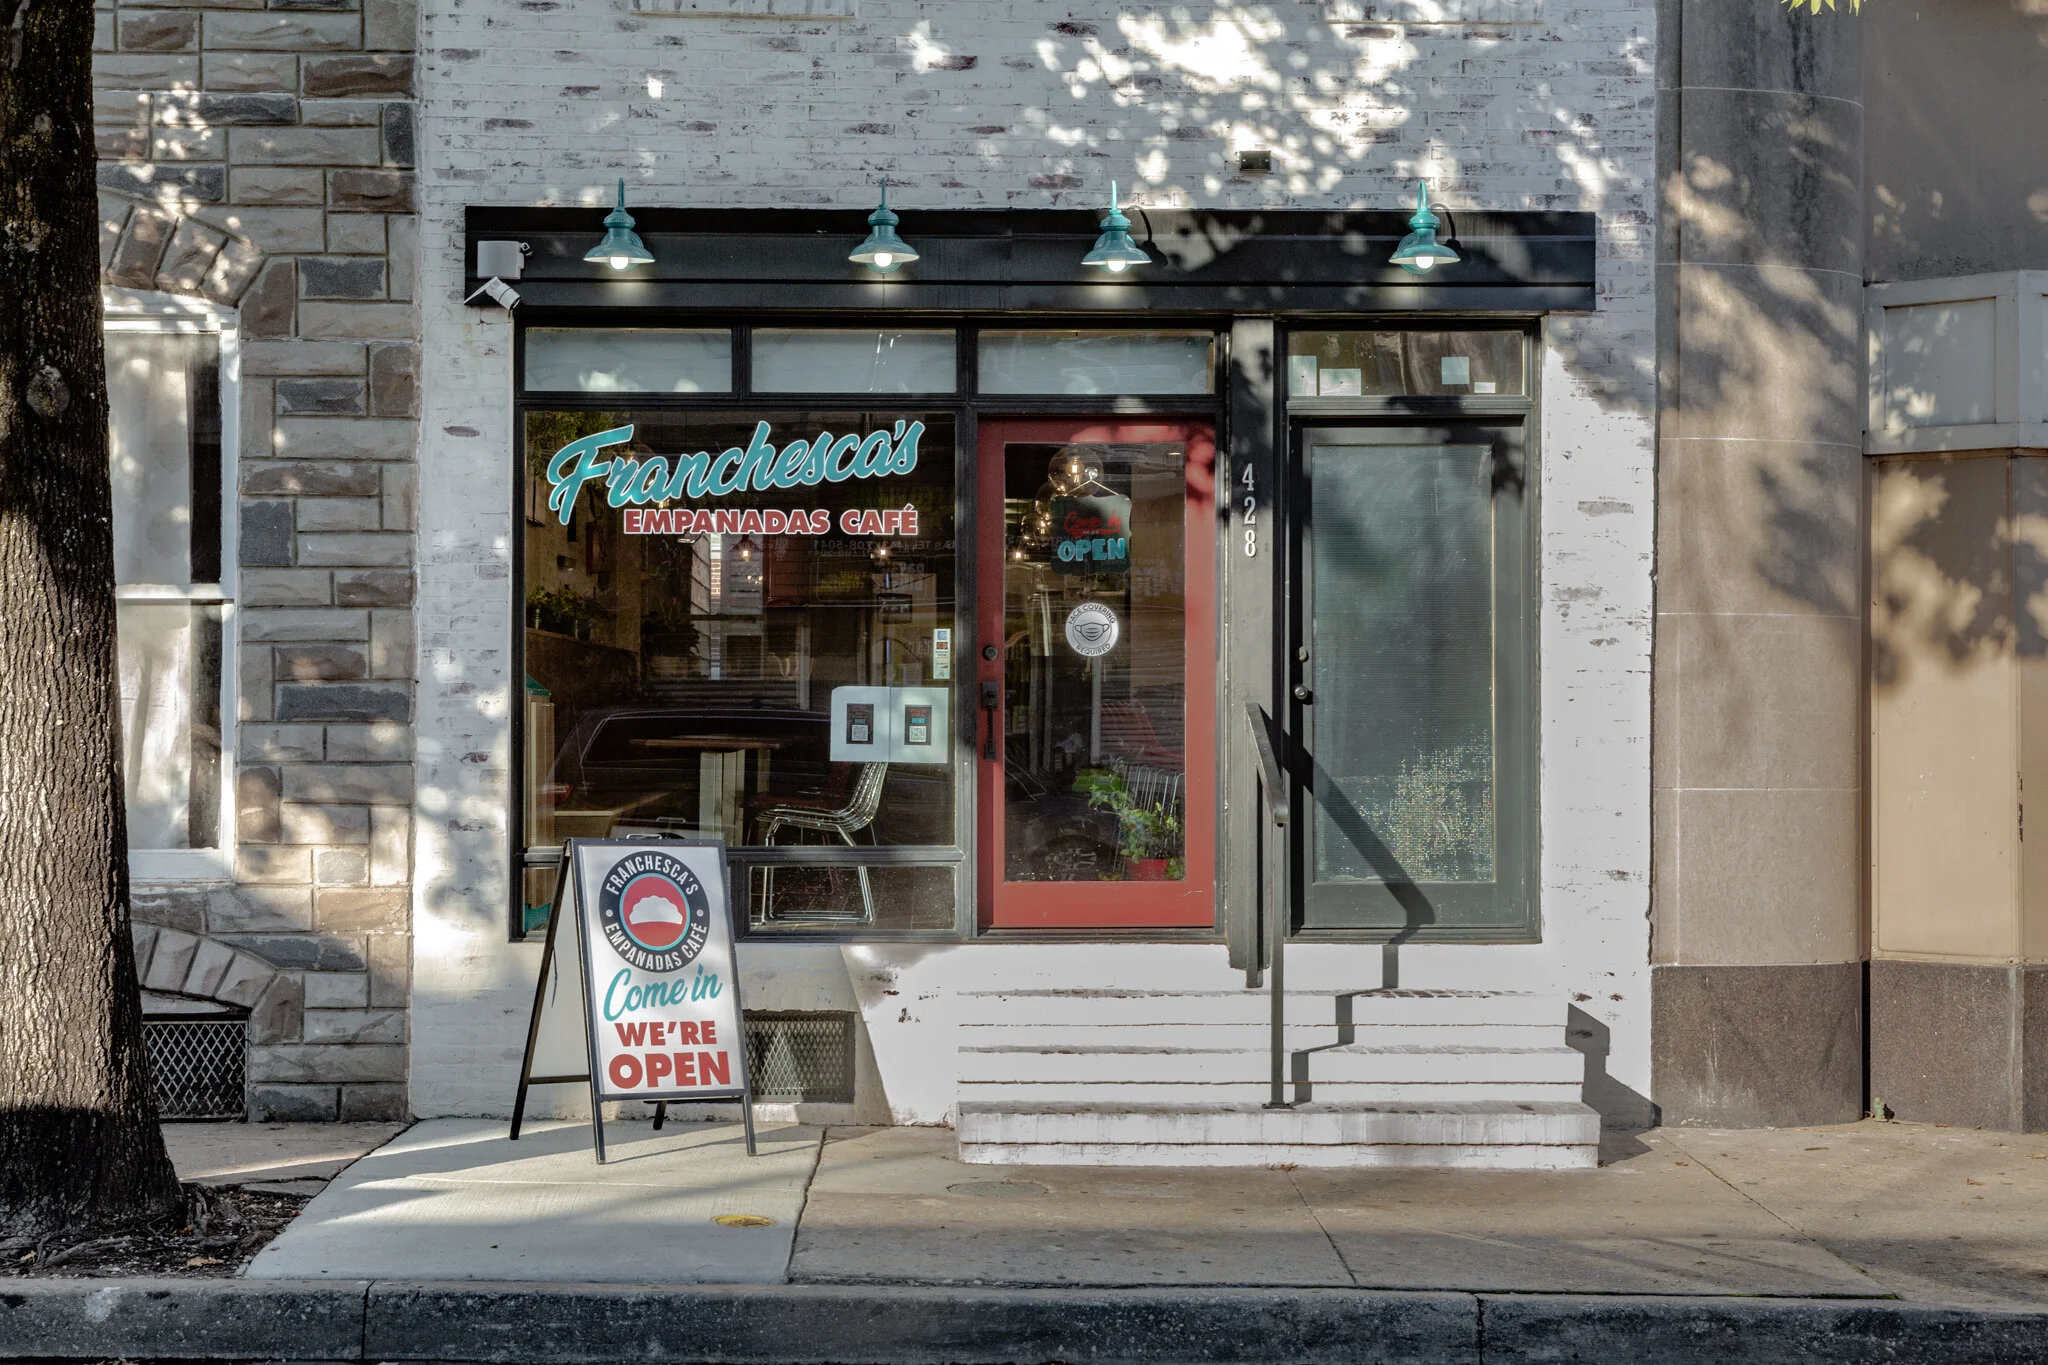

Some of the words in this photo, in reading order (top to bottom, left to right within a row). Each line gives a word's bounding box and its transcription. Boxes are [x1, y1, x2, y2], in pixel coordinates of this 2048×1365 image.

[547, 419, 926, 526] Franchesca's
[623, 508, 830, 535] EMPANADAS
[839, 503, 919, 535] CAFÉ
[1242, 462, 1257, 558] 428
[1057, 537, 1126, 562] OPEN
[1067, 607, 1083, 625] FACE
[1082, 603, 1116, 624] COVERING
[1076, 643, 1111, 655] REQUIRED
[605, 855, 699, 896] FRANCHESCA'S
[604, 922, 683, 971] EMPANADAS
[684, 922, 707, 960] CAFÉ
[603, 968, 688, 1022] Come
[690, 964, 723, 1002] in
[615, 1020, 718, 1047] WE'RE
[608, 1051, 731, 1089] OPEN
